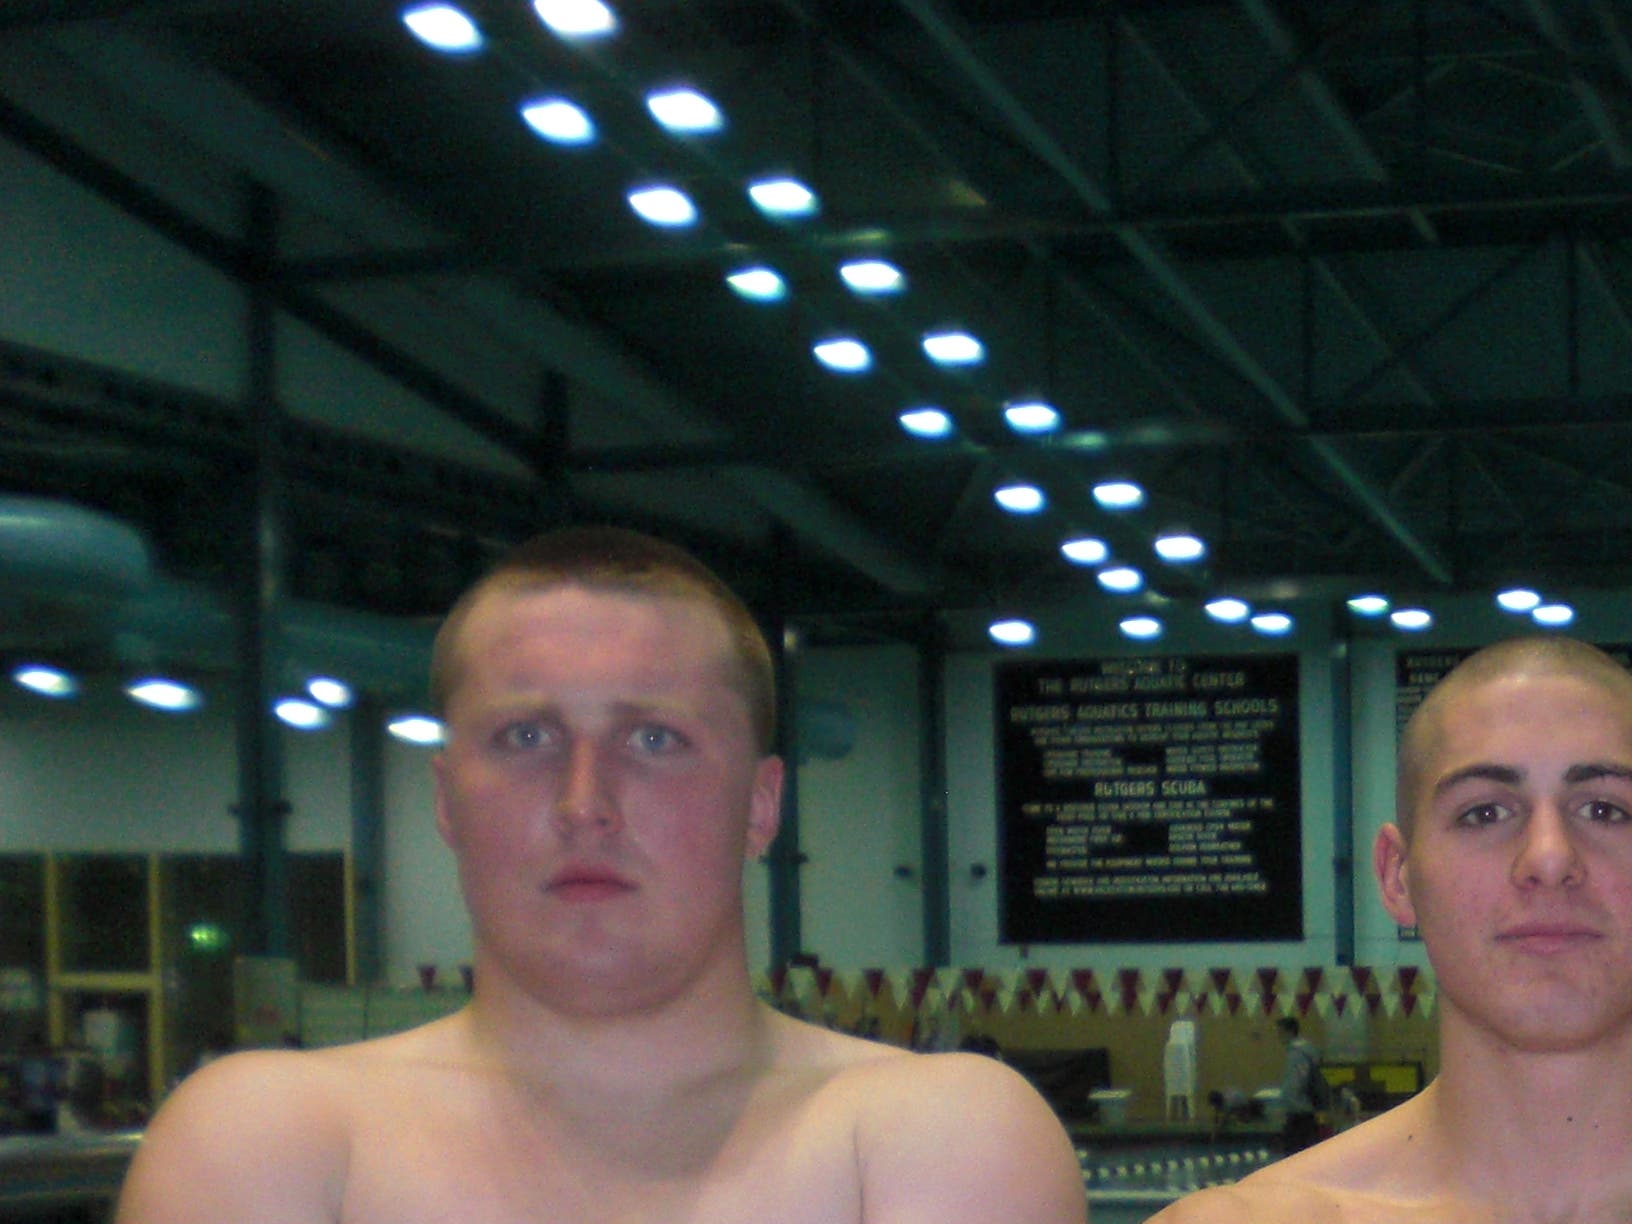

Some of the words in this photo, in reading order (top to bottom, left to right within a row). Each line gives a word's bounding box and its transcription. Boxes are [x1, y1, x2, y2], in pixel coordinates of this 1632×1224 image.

[1215, 698, 1278, 716] SCHOOLS
[1094, 780, 1154, 797] RUTGERS
[1161, 779, 1206, 797] SCUBA
